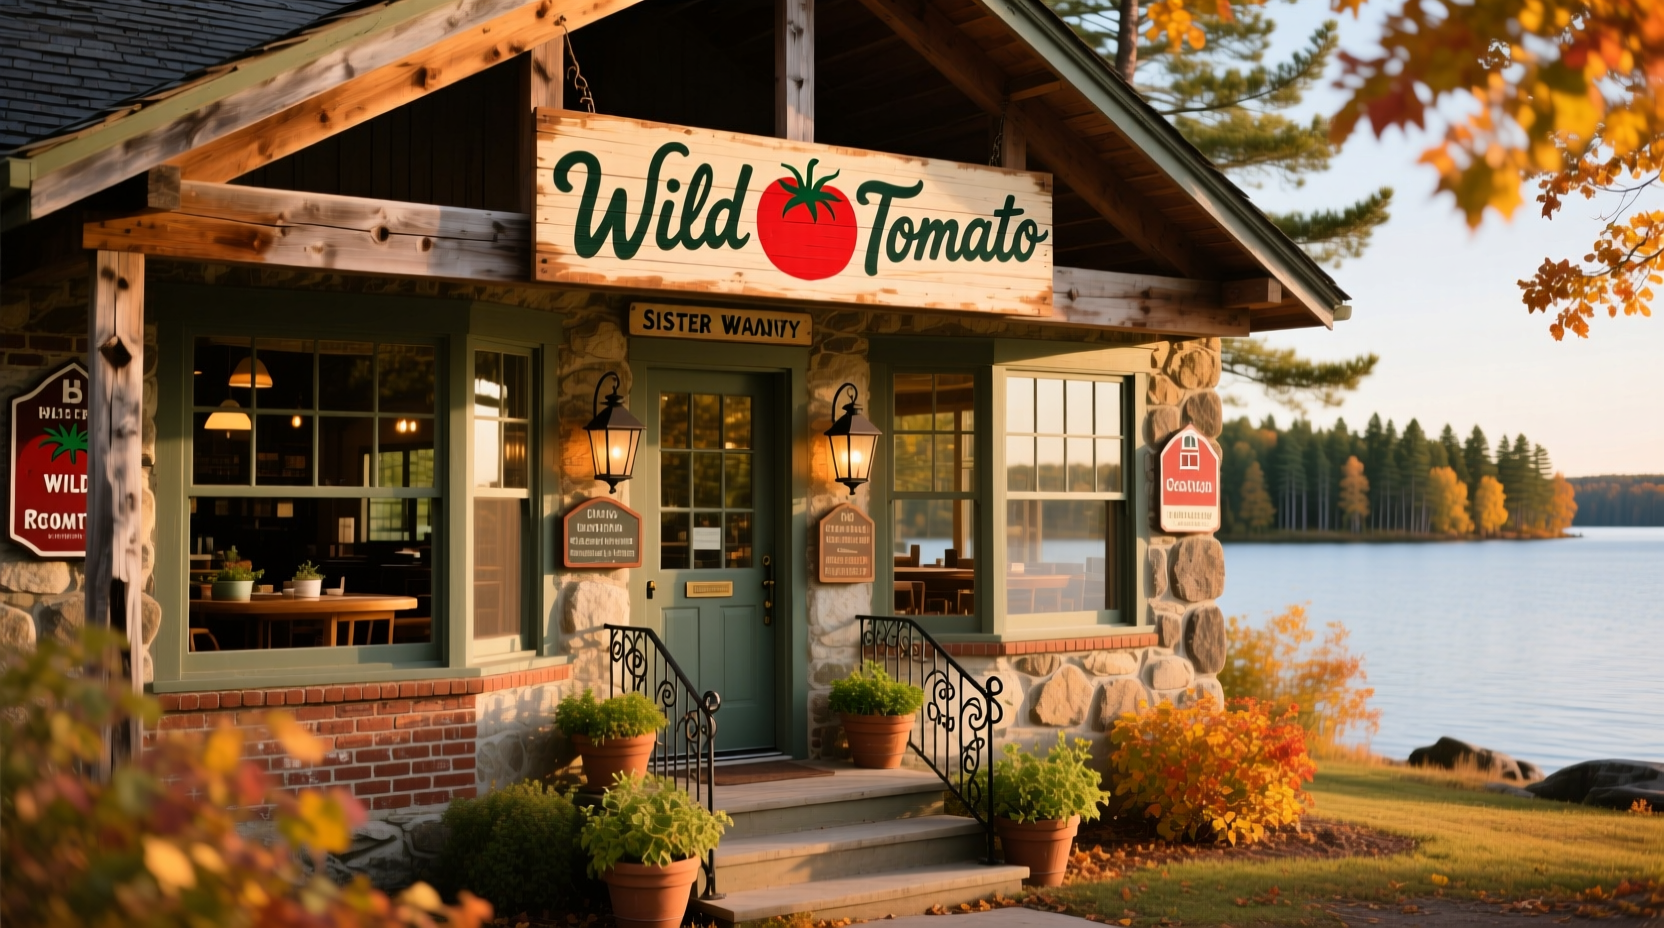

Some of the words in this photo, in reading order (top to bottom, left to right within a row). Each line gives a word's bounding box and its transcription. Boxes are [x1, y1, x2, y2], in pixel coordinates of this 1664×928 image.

[553, 141, 753, 260] Wild
[856, 180, 1049, 276] Tomato
[643, 309, 712, 334] SISTER
